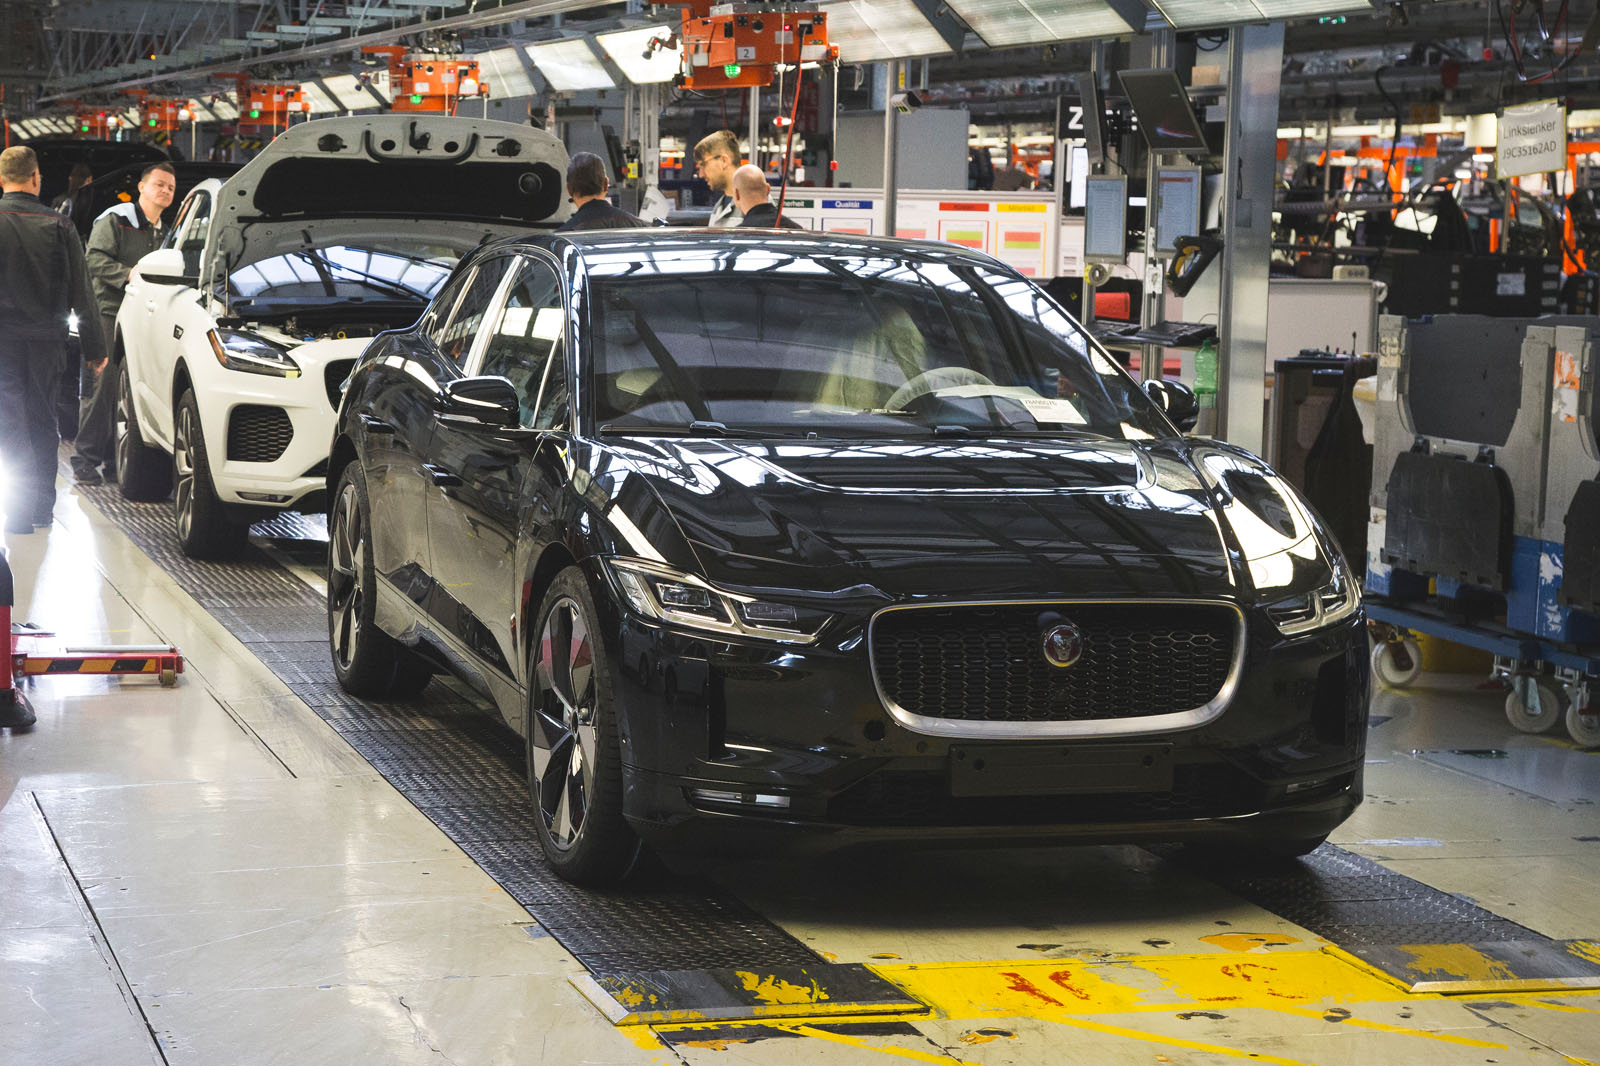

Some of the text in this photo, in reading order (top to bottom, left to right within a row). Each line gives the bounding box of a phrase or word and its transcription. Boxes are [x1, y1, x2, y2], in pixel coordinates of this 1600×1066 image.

[743, 48, 750, 58] 2
[1068, 106, 1084, 130] Z
[1503, 120, 1556, 139] Linkslenker
